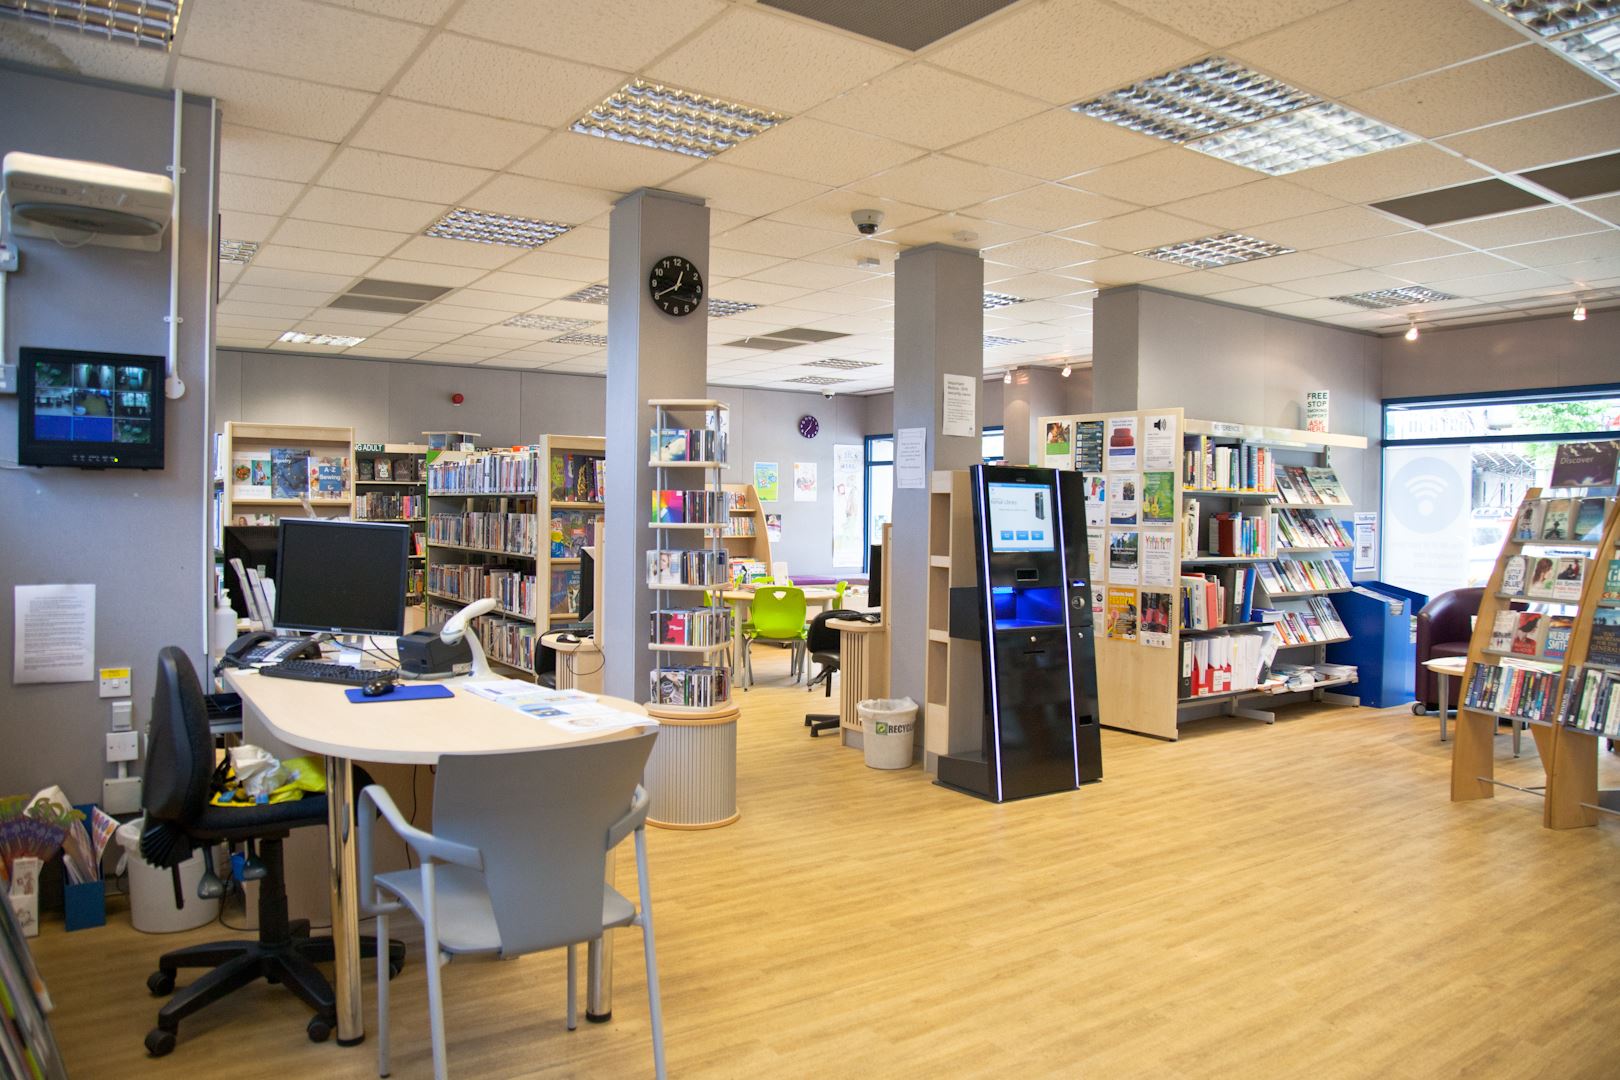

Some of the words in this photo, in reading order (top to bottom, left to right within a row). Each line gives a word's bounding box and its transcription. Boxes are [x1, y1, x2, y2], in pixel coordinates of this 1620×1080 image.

[662, 260, 670, 269] 11
[673, 258, 682, 267] 12
[685, 263, 690, 271] 1
[654, 268, 664, 276] 10
[693, 272, 699, 281] 2
[651, 279, 658, 288] 9
[695, 285, 701, 294] 3
[692, 297, 698, 305] 4
[663, 302, 669, 310] 7
[673, 306, 679, 314] 6
[684, 305, 690, 313] 5
[1307, 392, 1328, 400] FREE
[1307, 425, 1326, 433] HERE
[363, 444, 383, 452] ADULT
[1560, 456, 1594, 465] Discover
[1504, 580, 1521, 588] BLUE
